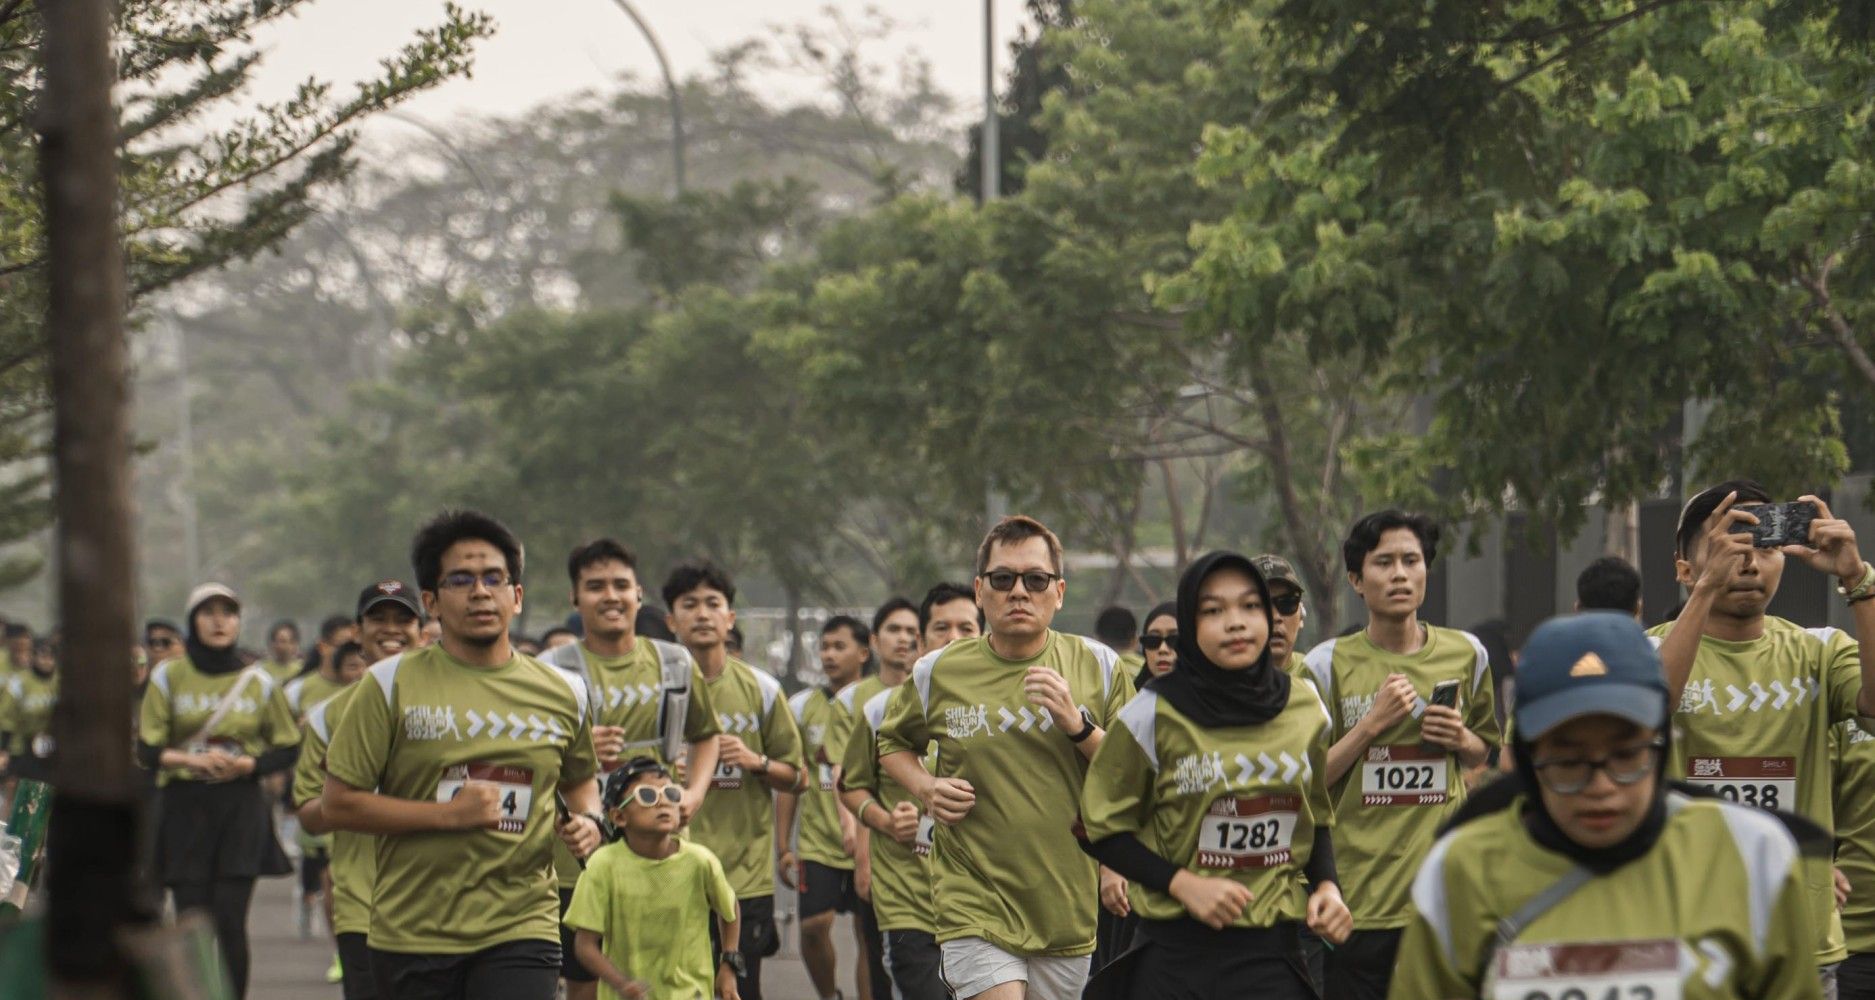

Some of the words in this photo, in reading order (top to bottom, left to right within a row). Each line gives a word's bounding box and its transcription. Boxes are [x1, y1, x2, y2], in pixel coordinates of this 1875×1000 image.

[945, 704, 977, 721] SHILA
[946, 725, 970, 738] 2025
[1374, 766, 1434, 790] 1022
[1216, 818, 1280, 850] 1282
